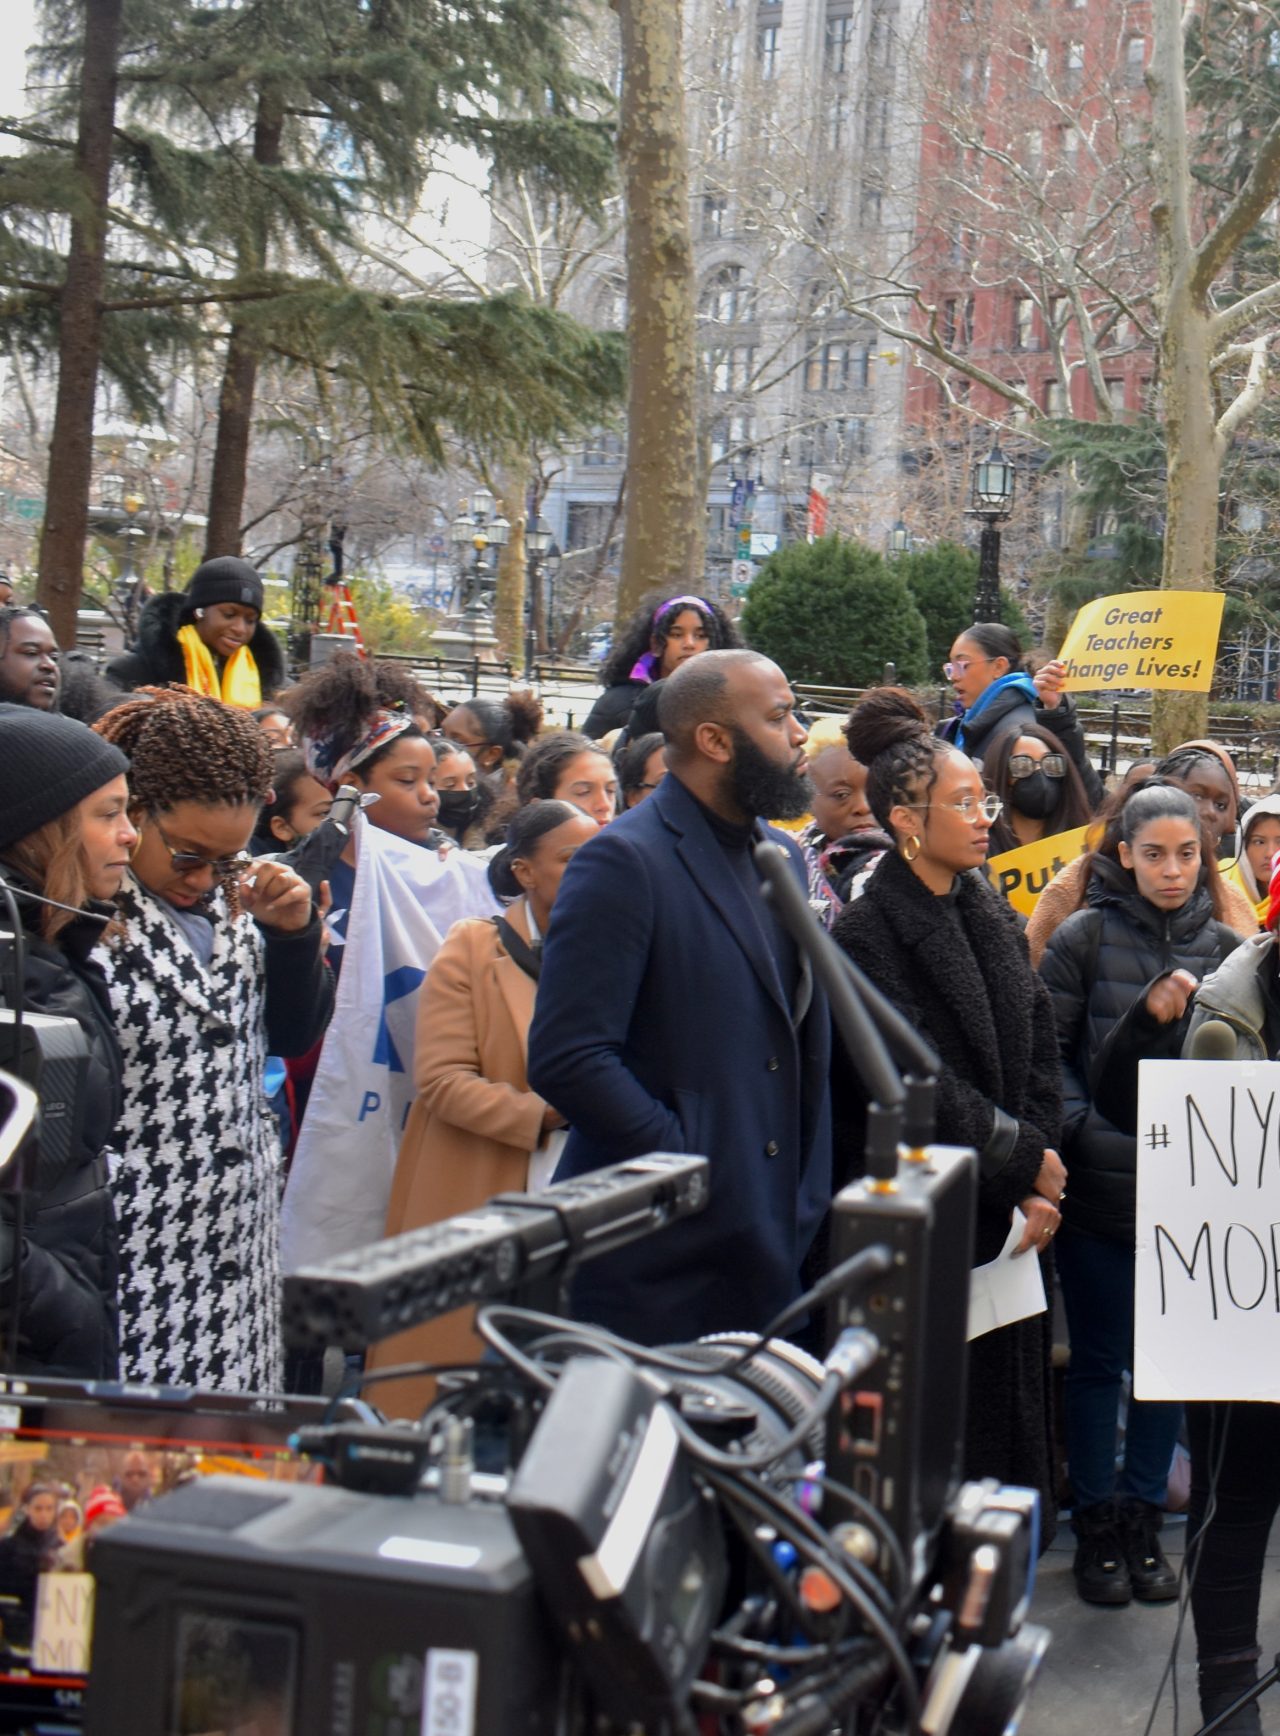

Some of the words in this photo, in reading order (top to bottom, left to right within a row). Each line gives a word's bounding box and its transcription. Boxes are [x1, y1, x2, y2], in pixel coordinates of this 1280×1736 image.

[1104, 607, 1162, 626] Great
[1086, 630, 1174, 651] Teachers
[1064, 657, 1129, 682] hange
[1135, 656, 1202, 678] Lives!
